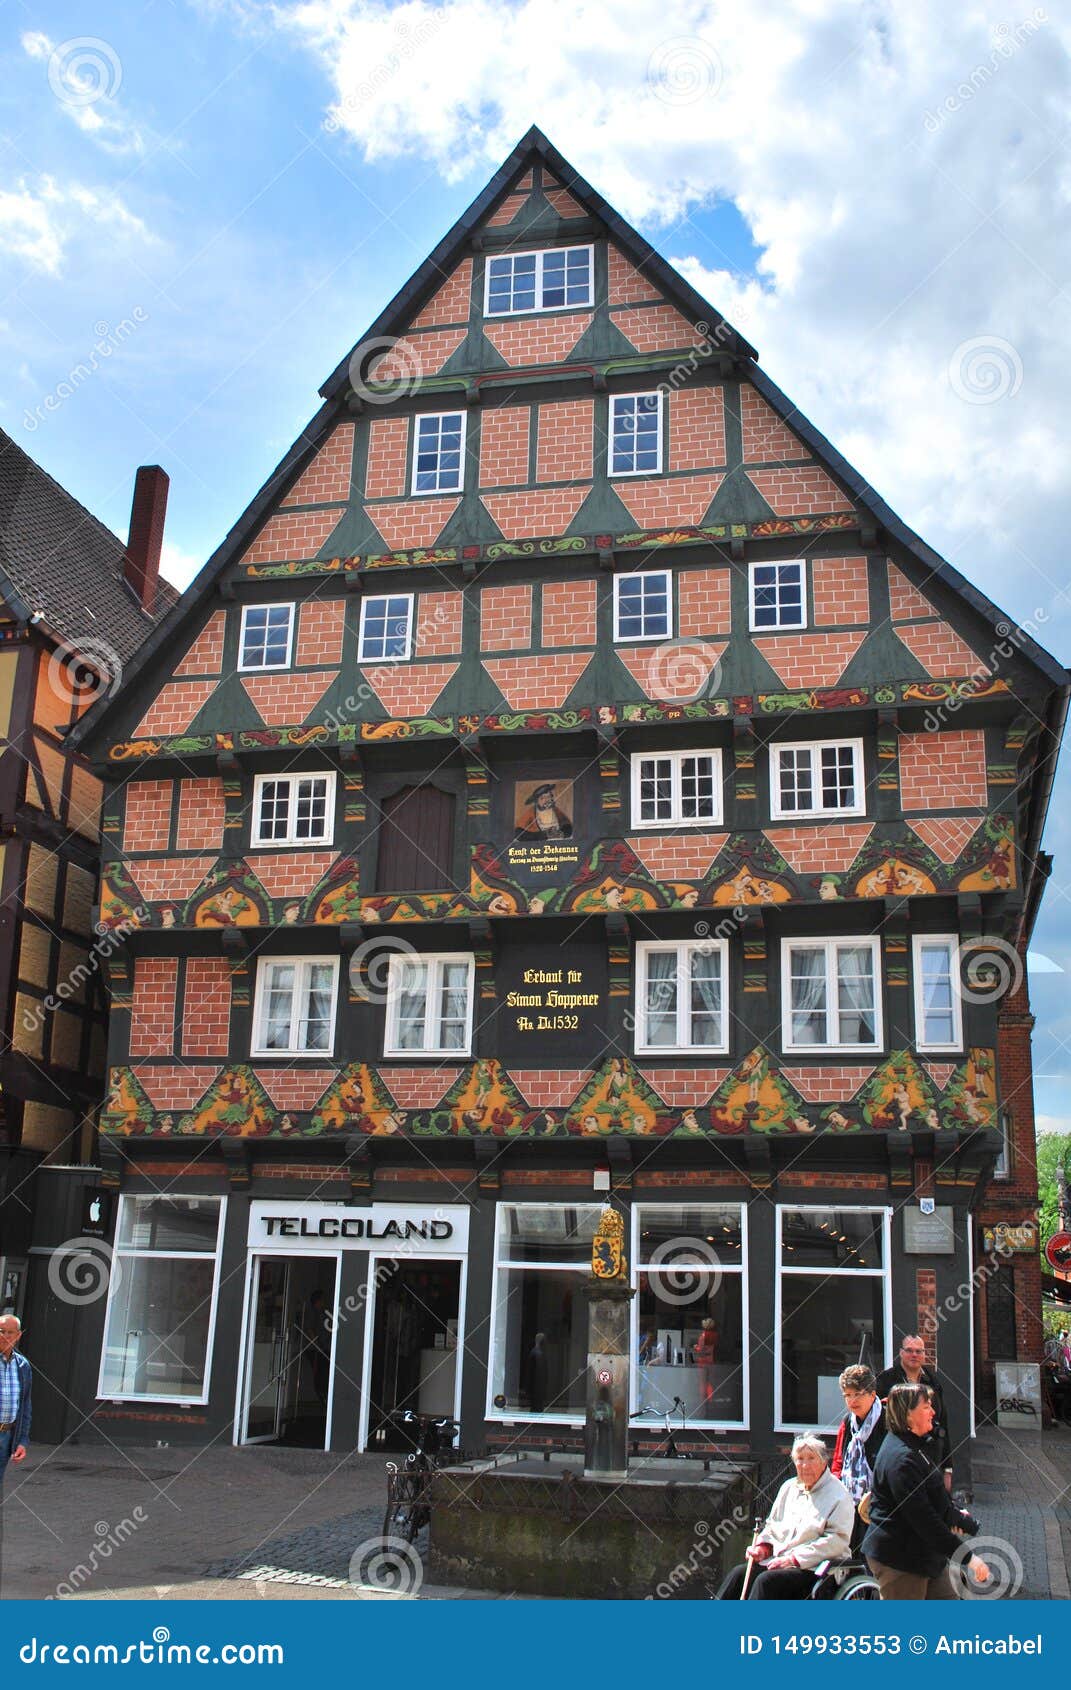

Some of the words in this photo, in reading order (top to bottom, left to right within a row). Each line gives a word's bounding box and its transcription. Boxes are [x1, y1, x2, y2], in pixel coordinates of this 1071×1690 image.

[524, 969, 563, 983] Erbaut
[567, 970, 583, 984] für
[506, 991, 542, 1007] Simon
[545, 990, 599, 1009] Hoppener
[260, 1216, 453, 1240] TELCOLAND
